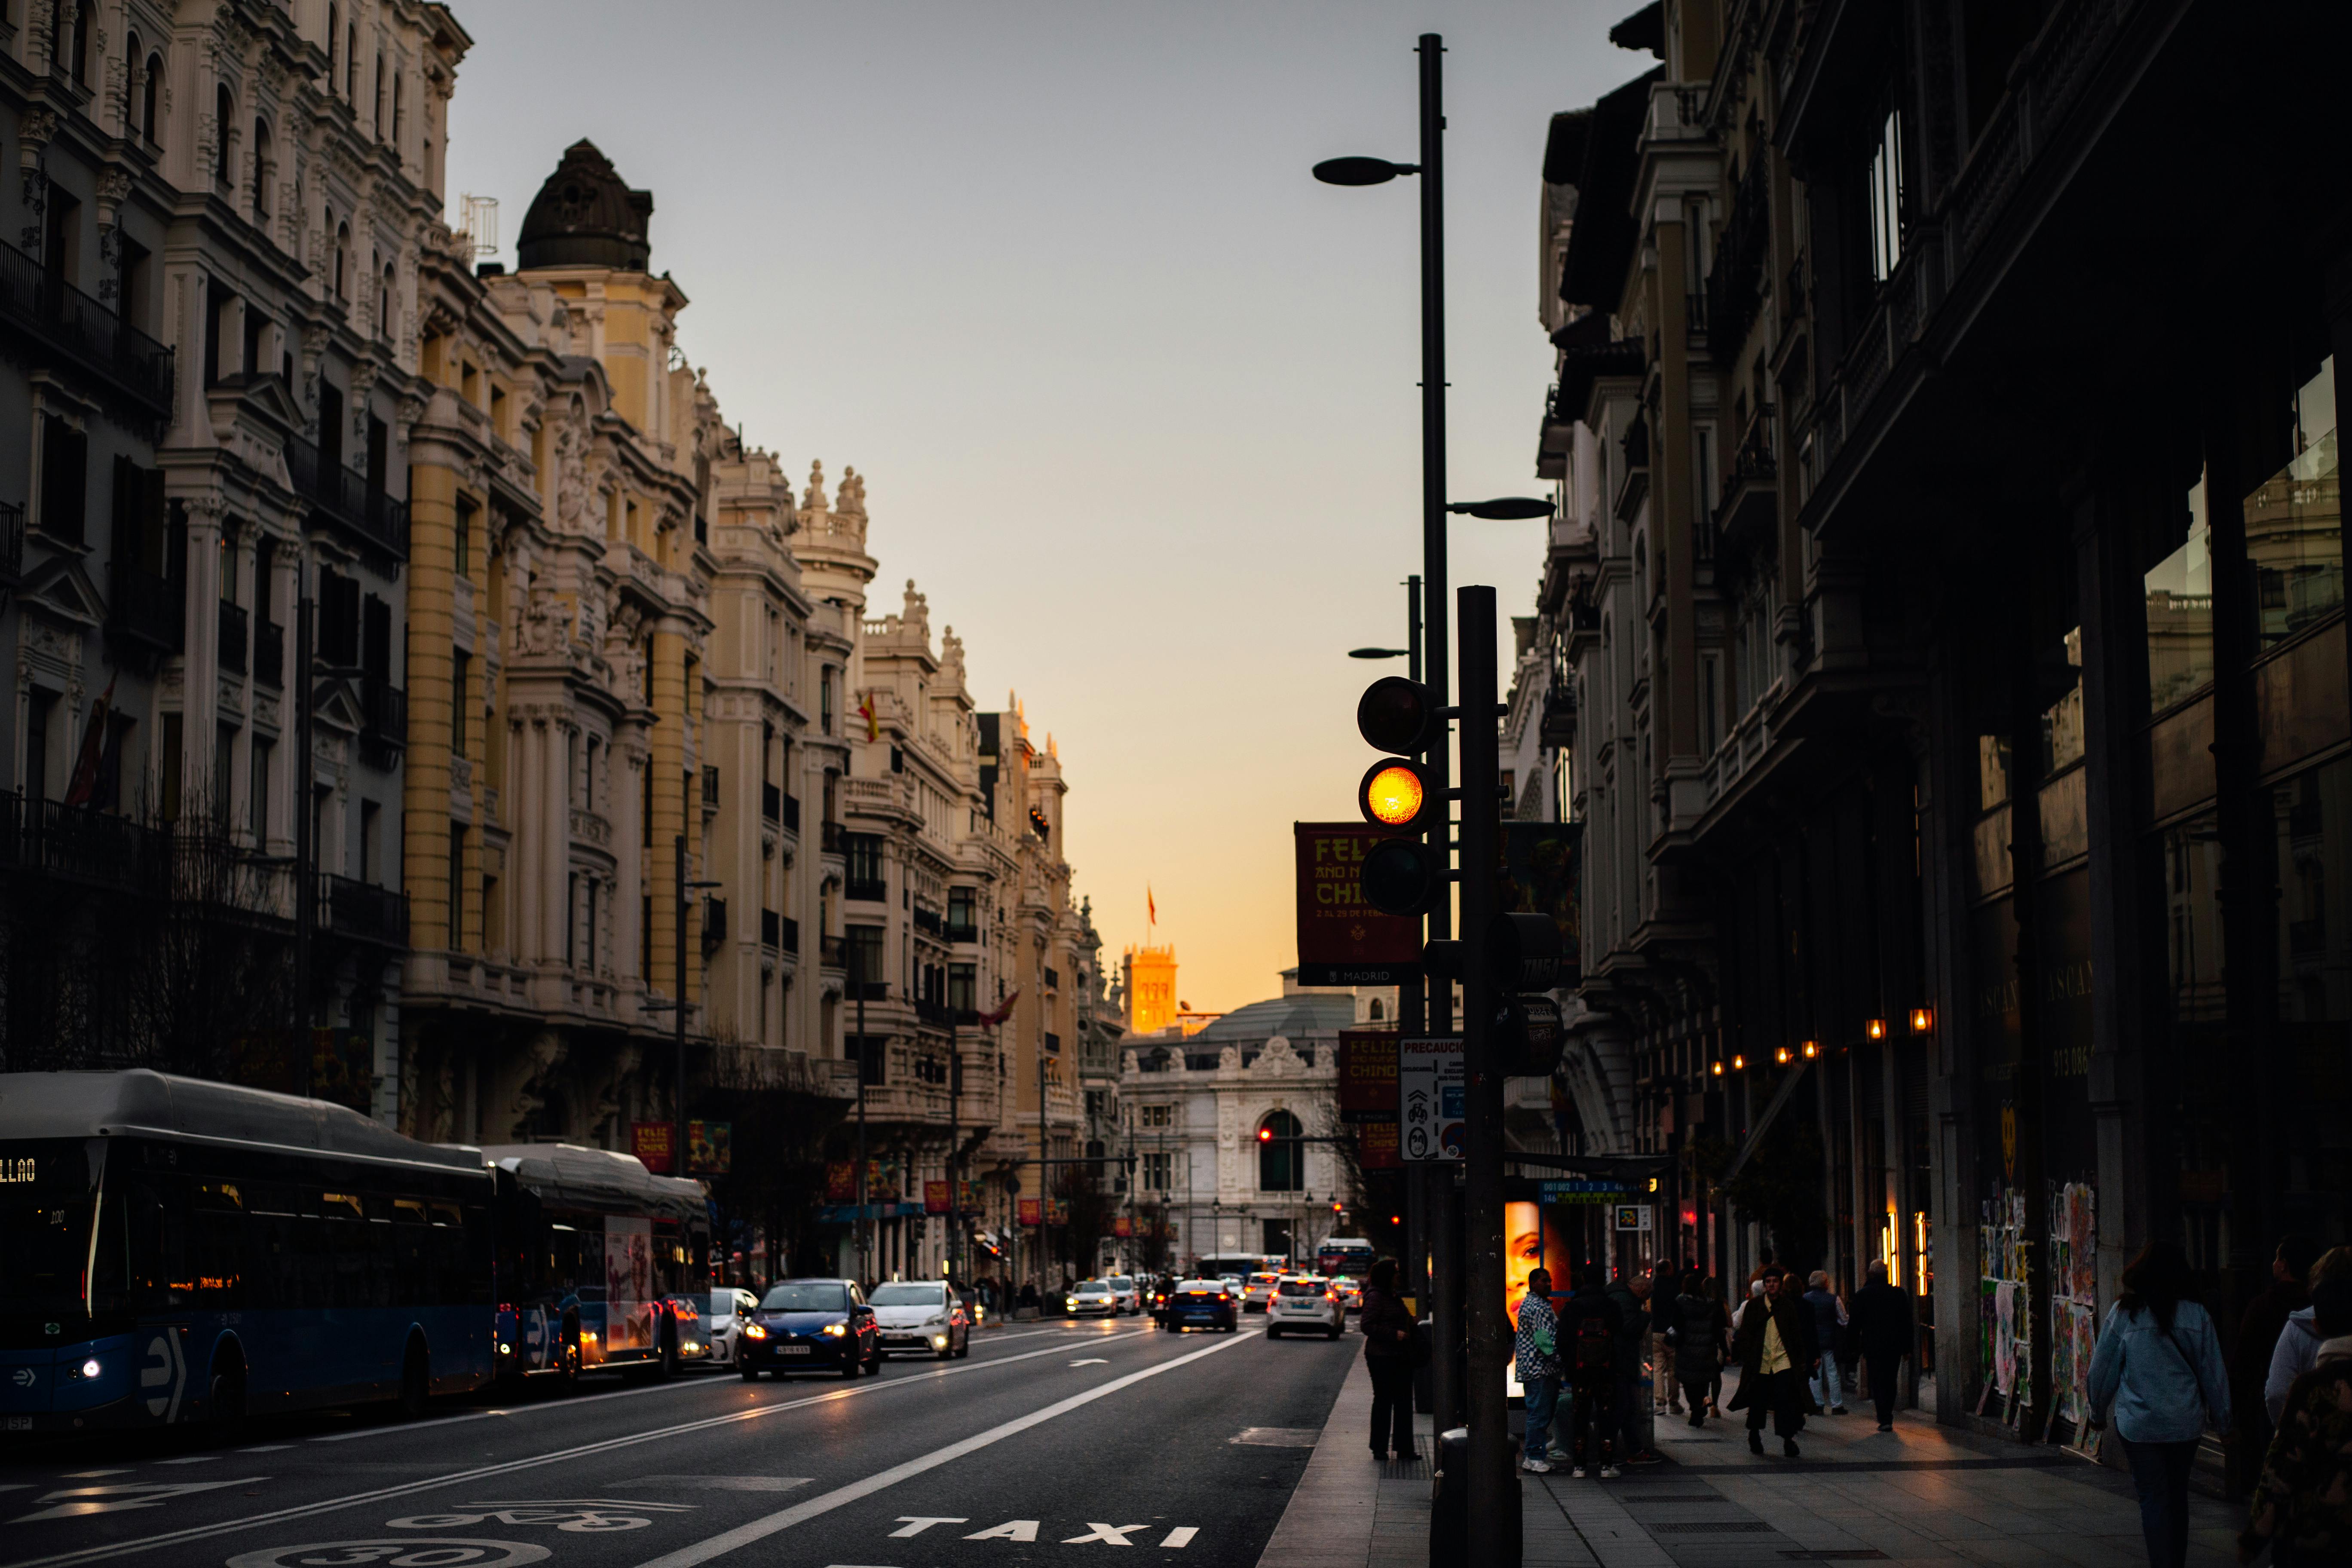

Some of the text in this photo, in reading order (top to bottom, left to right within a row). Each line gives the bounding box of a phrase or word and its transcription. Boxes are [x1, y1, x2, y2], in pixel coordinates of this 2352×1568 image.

[1314, 838, 1392, 862] FEL
[1314, 863, 1345, 879] AÑO
[1316, 882, 1368, 904] CHI
[1344, 971, 1390, 980] MADRID
[1351, 1040, 1397, 1053] FELIZ
[2054, 1048, 2069, 1077] 913
[1350, 1064, 1397, 1077] CHINO
[1544, 1182, 1556, 1191] 001
[1557, 1182, 1570, 1191] 002
[1575, 1182, 1579, 1191] 1
[1589, 1182, 1593, 1191] 2
[1602, 1182, 1607, 1191] 3
[1614, 1182, 1624, 1191] 46
[1544, 1194, 1557, 1203] 146
[10, 1418, 29, 1429] SP
[887, 1516, 1200, 1548] TAXI
[300, 1547, 485, 1567] 30
